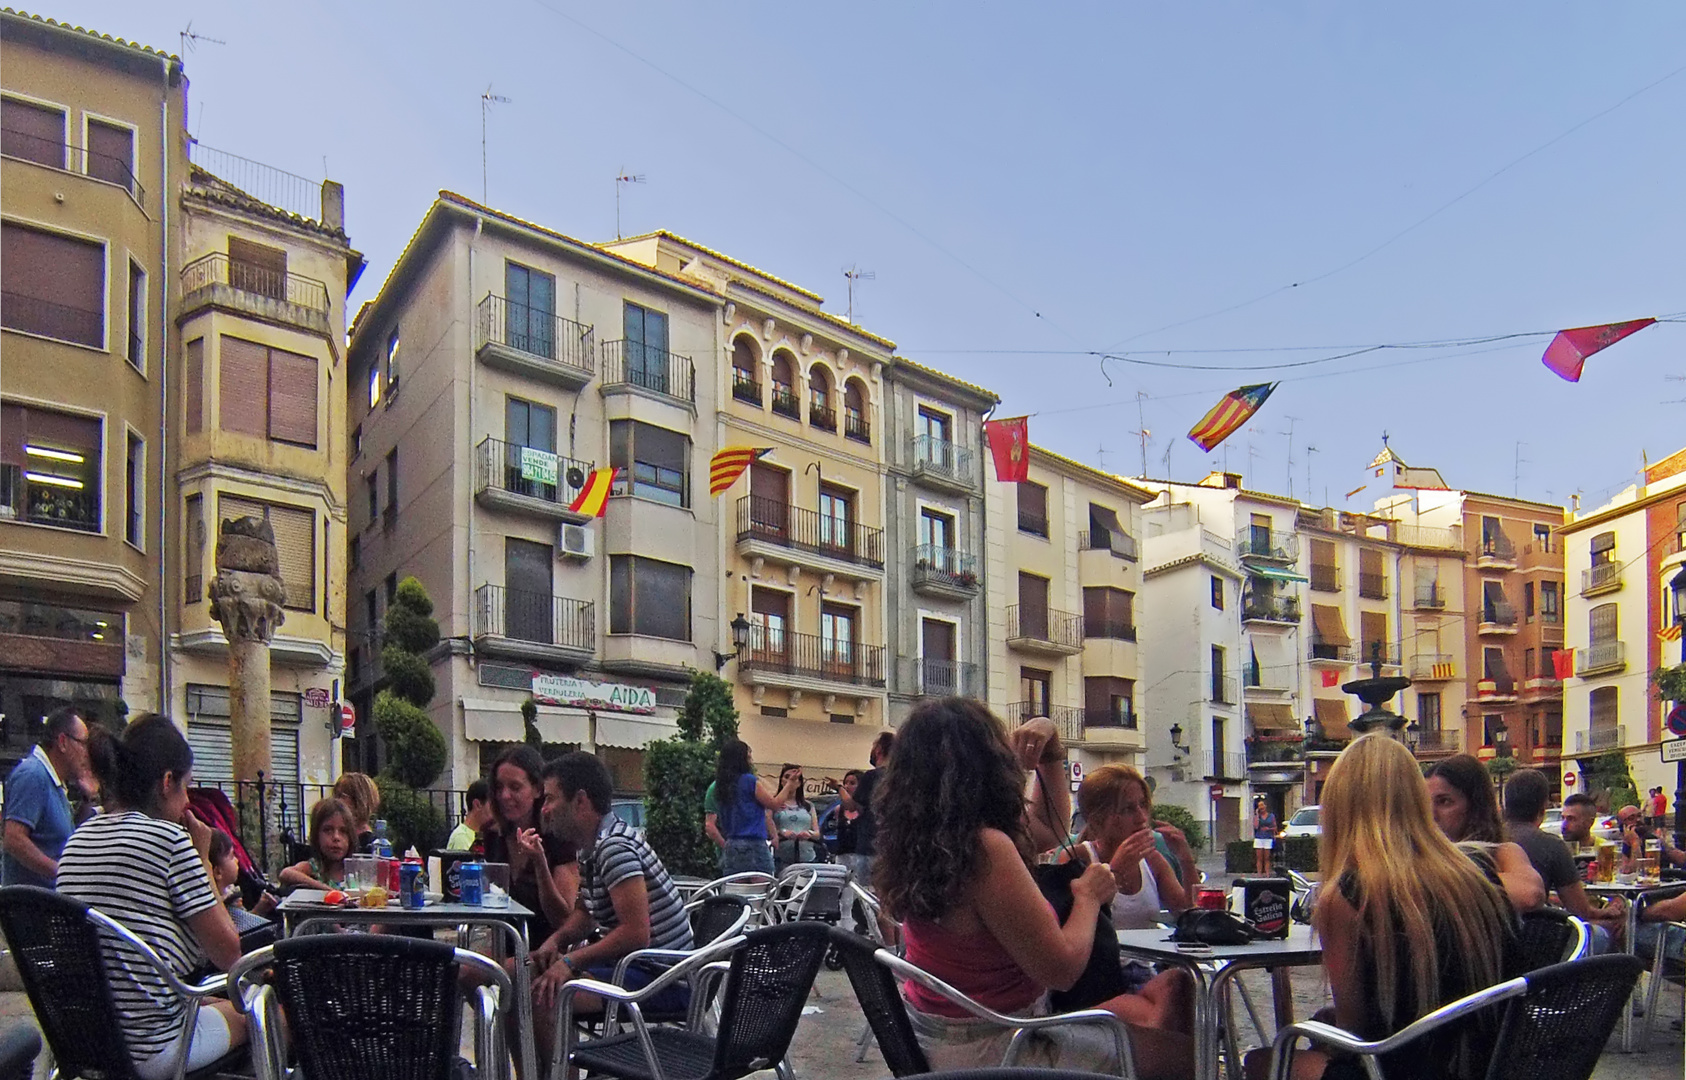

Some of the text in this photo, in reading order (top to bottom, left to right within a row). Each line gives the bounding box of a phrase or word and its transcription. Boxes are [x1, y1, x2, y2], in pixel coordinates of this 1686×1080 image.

[523, 456, 548, 467] VENDE
[609, 686, 651, 706] AIDA
[1254, 903, 1283, 916] Estrella
[1257, 911, 1283, 922] Galicia
